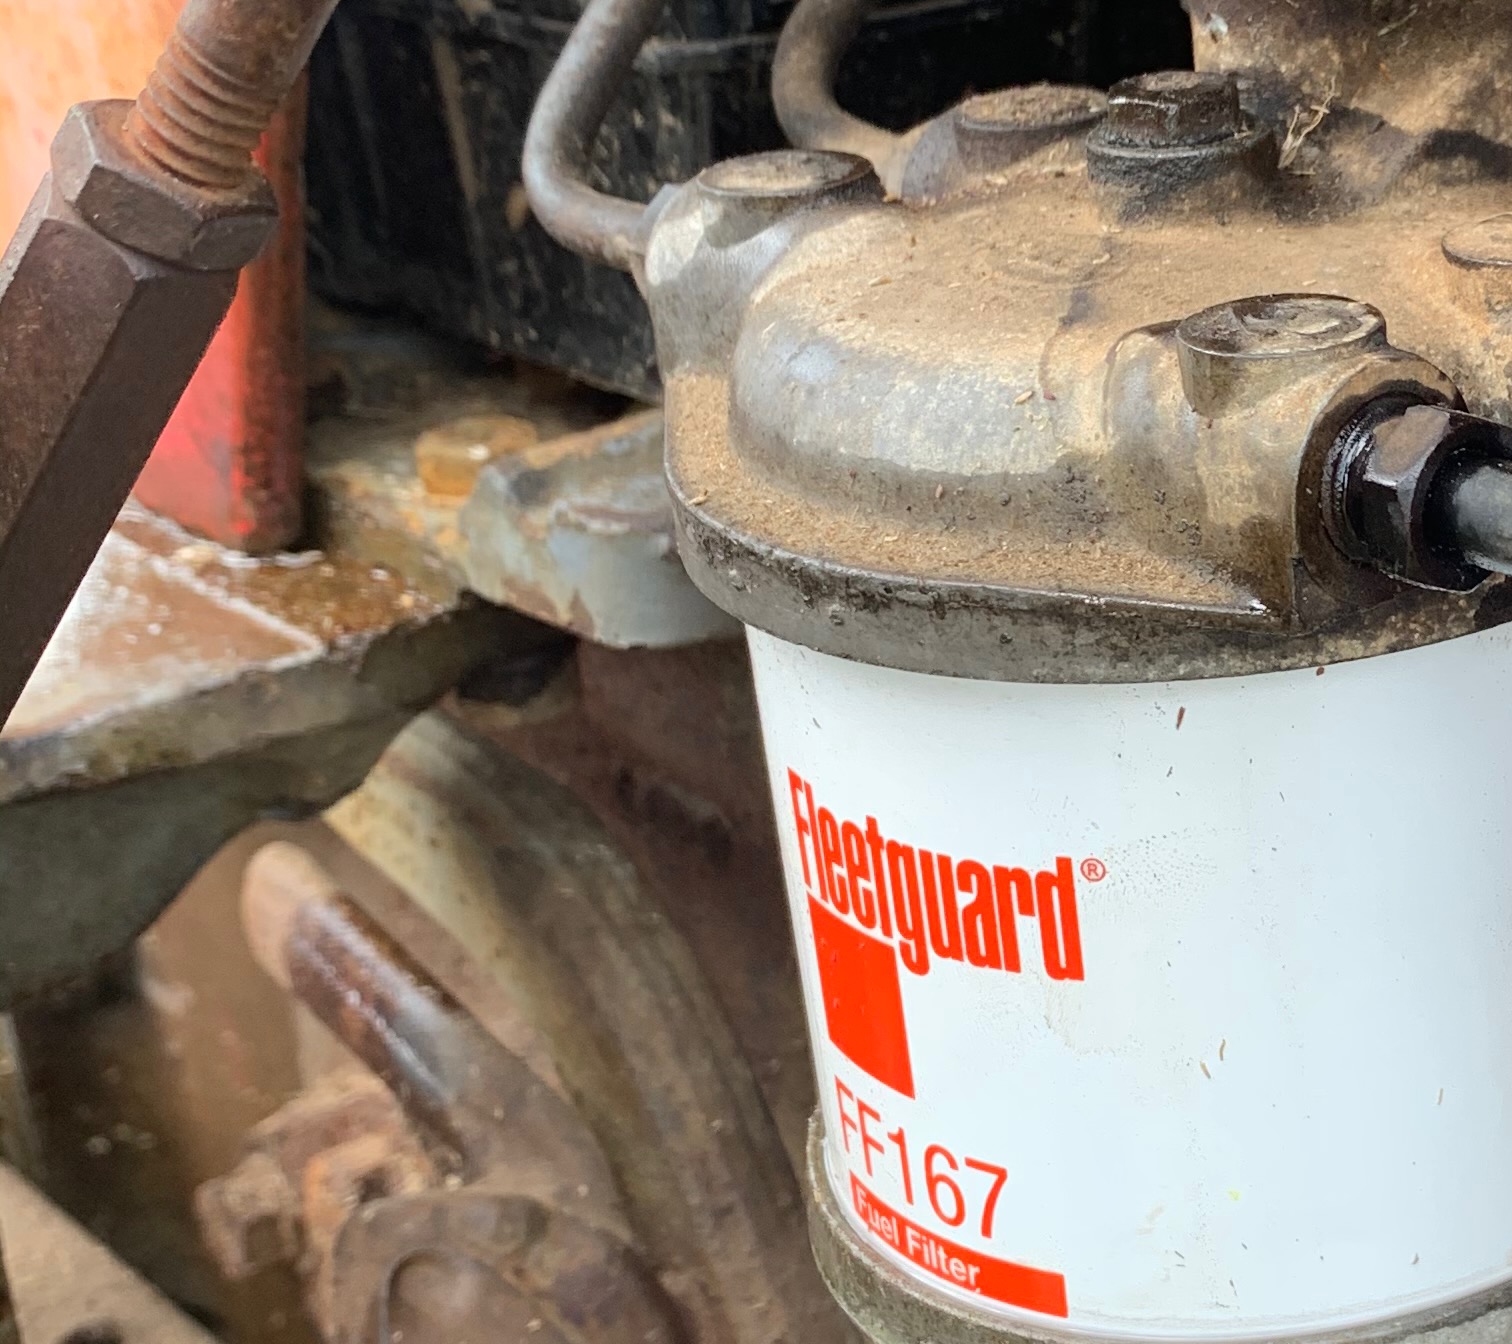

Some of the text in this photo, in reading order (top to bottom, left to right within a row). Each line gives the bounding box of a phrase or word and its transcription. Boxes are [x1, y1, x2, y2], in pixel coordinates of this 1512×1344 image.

[835, 1076, 1008, 1238] FF167
[855, 1184, 981, 1287] Fuel Filter
